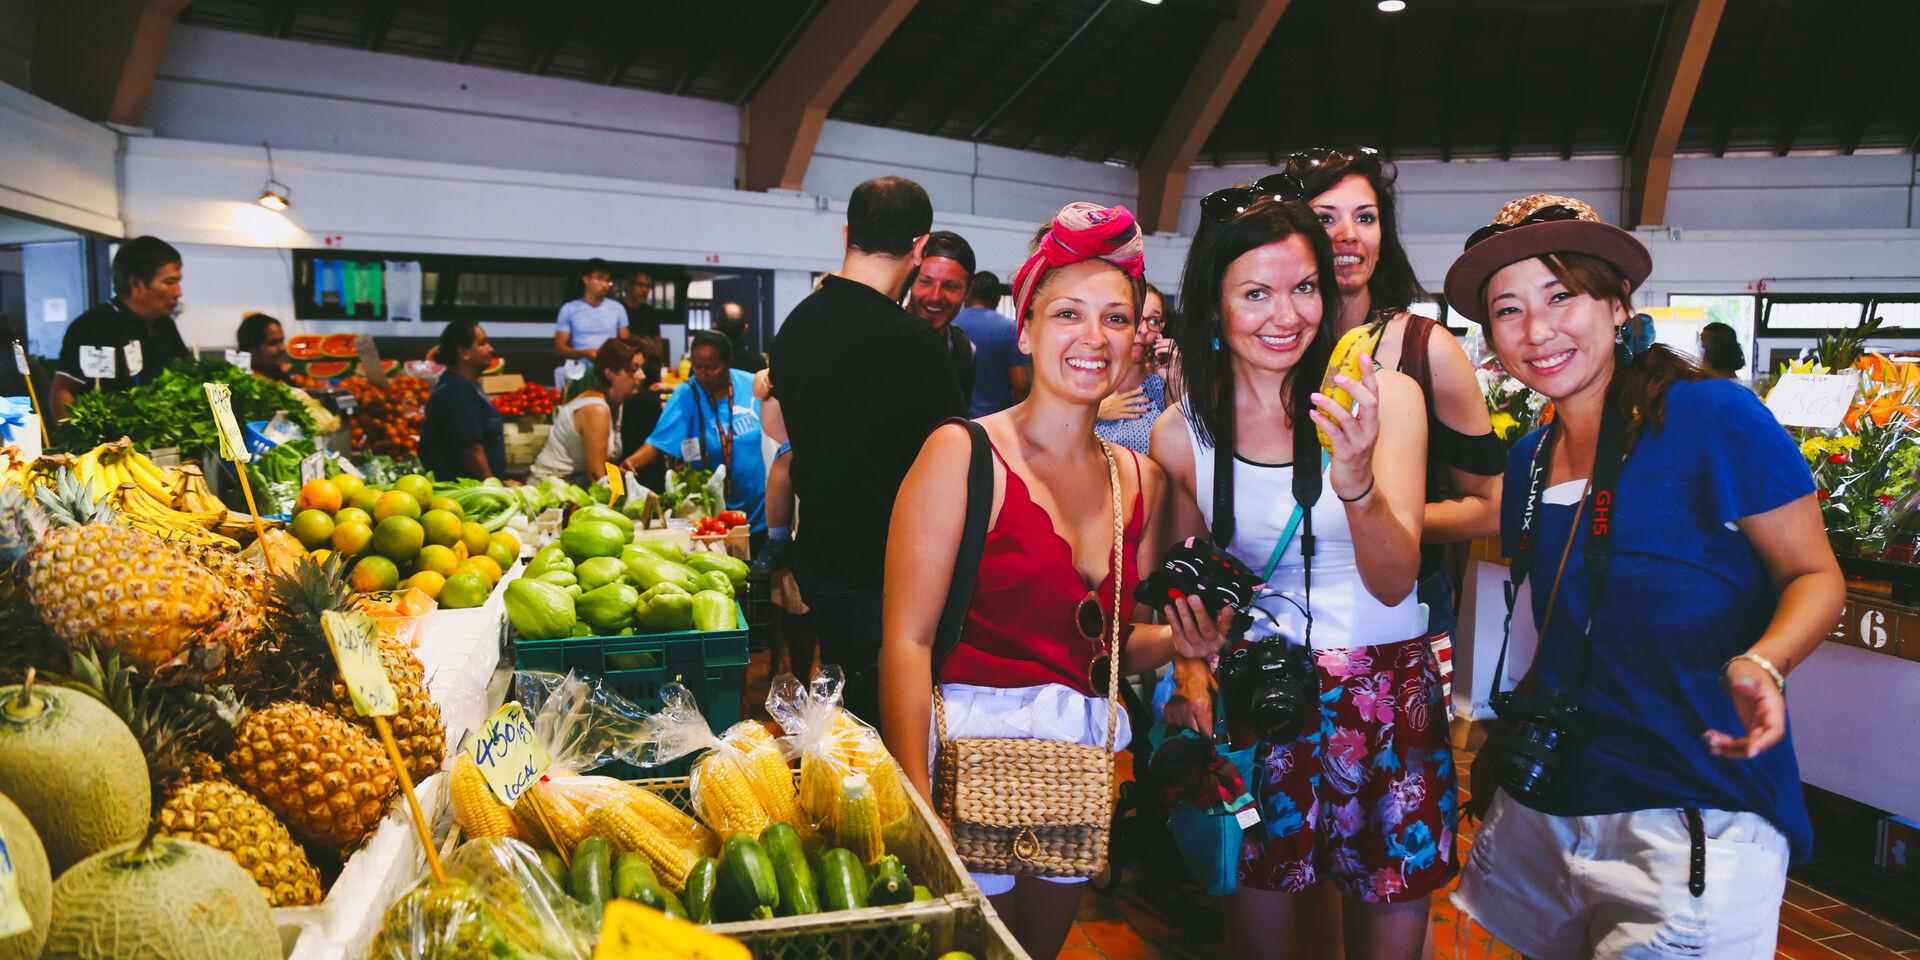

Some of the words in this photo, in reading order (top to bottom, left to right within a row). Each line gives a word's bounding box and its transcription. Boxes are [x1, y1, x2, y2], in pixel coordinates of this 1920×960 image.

[1521, 466, 1543, 531] LUMIX
[1592, 490, 1611, 536] GH5
[1262, 662, 1283, 671] Canon
